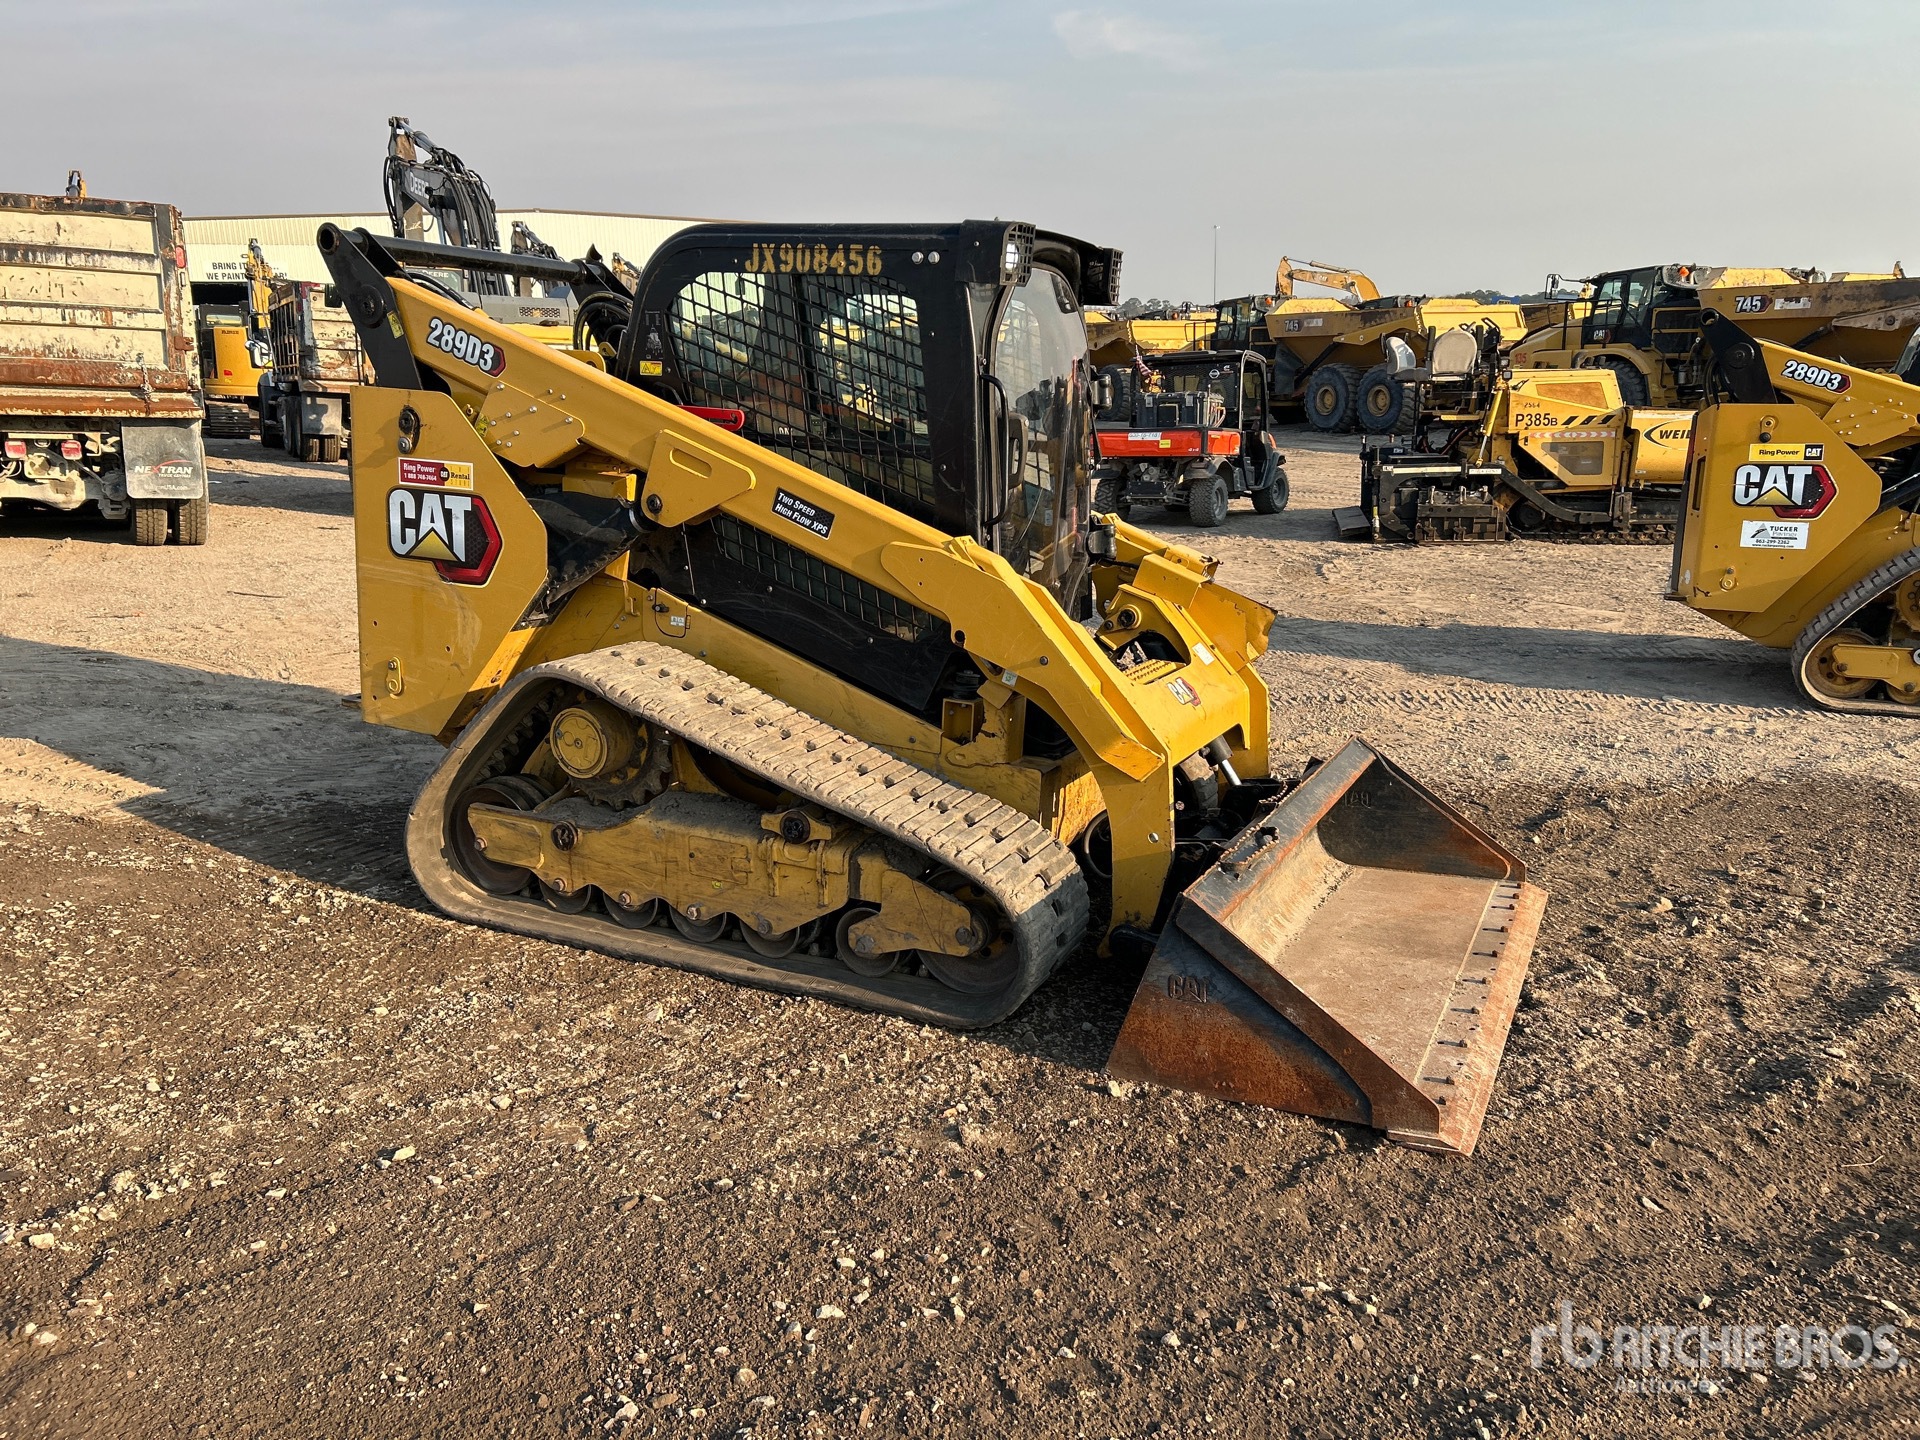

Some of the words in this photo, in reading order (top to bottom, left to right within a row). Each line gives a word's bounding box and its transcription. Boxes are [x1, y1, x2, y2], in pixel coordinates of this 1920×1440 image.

[212, 262, 237, 270] BRING
[239, 262, 246, 270] IT
[745, 243, 882, 275] JX908456
[206, 272, 219, 280] WE
[222, 272, 245, 280] PAINT
[1735, 296, 1762, 312] 745
[1285, 320, 1299, 332] 745
[1594, 330, 1605, 340] CAT
[427, 318, 495, 371] 289D3
[1782, 360, 1842, 390] 289D3
[1515, 413, 1558, 427] P385B
[1805, 448, 1822, 457] CAT
[134, 465, 193, 474] NEXTRAN
[403, 463, 416, 472] Ring
[417, 464, 436, 473] Power
[451, 472, 470, 480] Rental
[1734, 465, 1813, 506] CAT
[778, 492, 793, 506] TWO
[793, 500, 815, 517] SPEED
[389, 489, 472, 562] CAT
[775, 503, 793, 518] HIGH
[792, 511, 812, 527] FLOW
[811, 521, 828, 535] XPS
[1166, 677, 1195, 705] CAT
